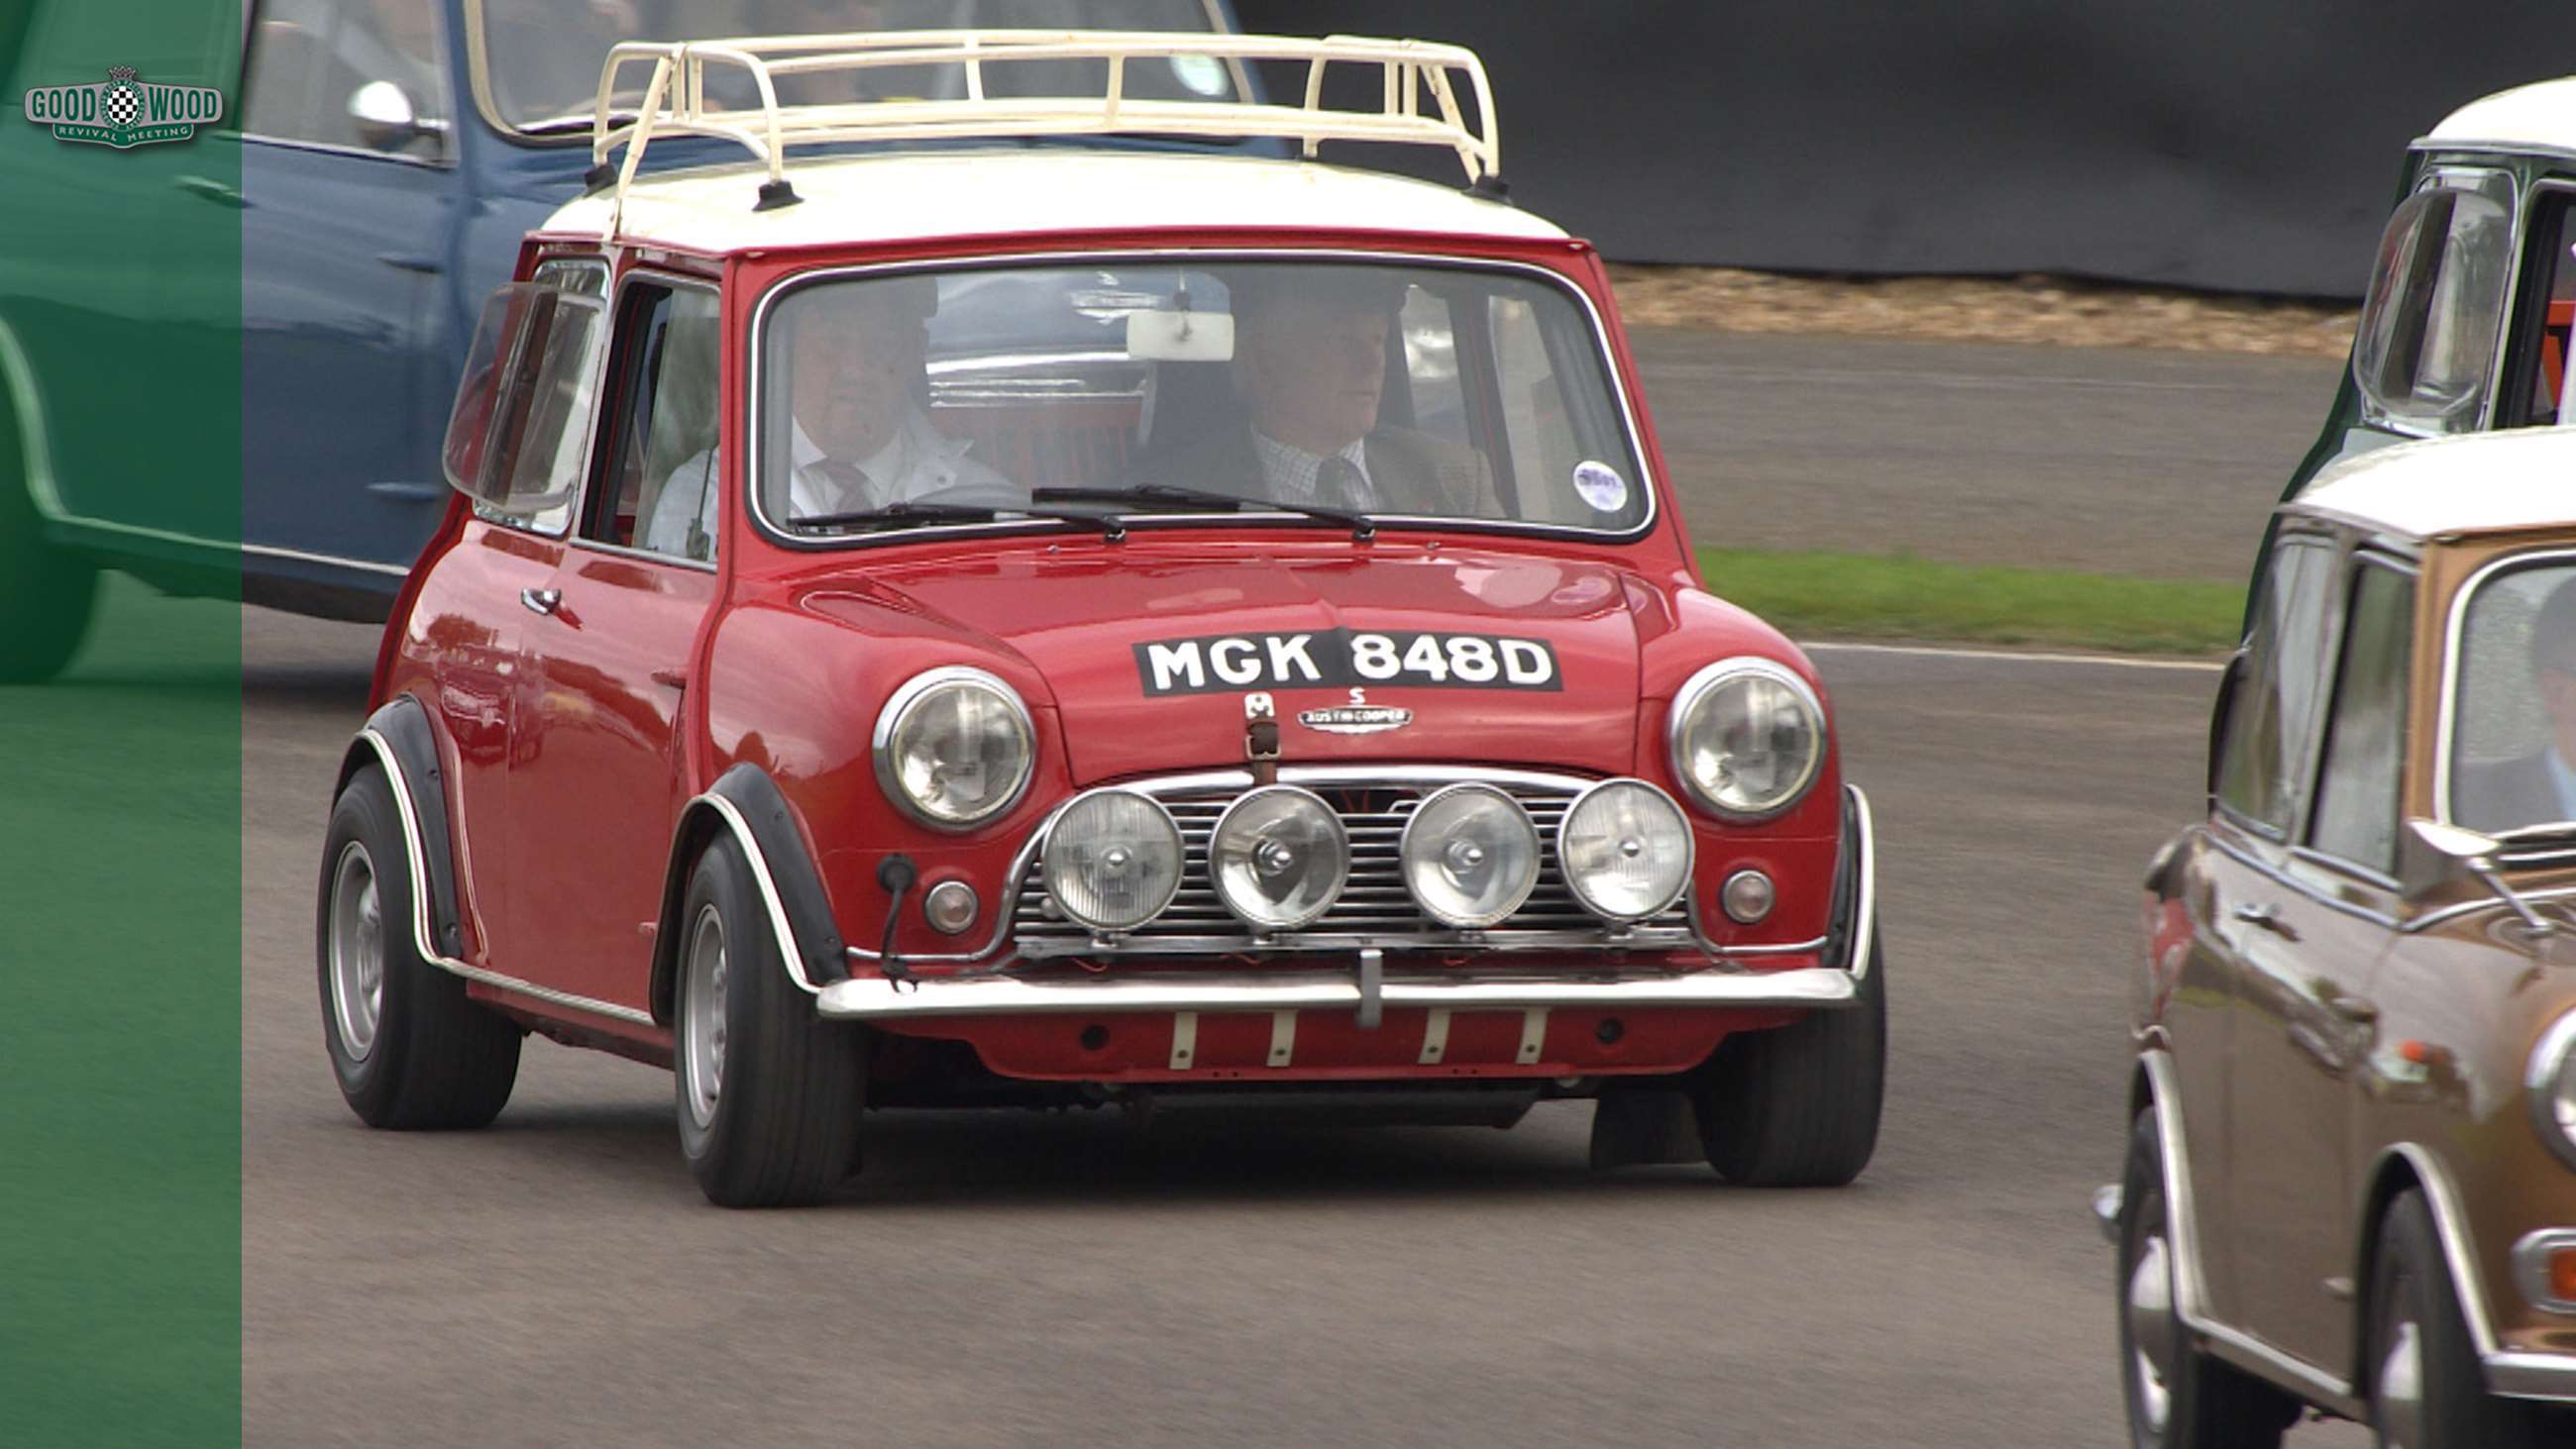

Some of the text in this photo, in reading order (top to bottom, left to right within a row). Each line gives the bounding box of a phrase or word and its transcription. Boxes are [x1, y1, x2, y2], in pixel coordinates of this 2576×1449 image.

[1146, 633, 1553, 691] MGK 848D
[1348, 686, 1366, 704] S
